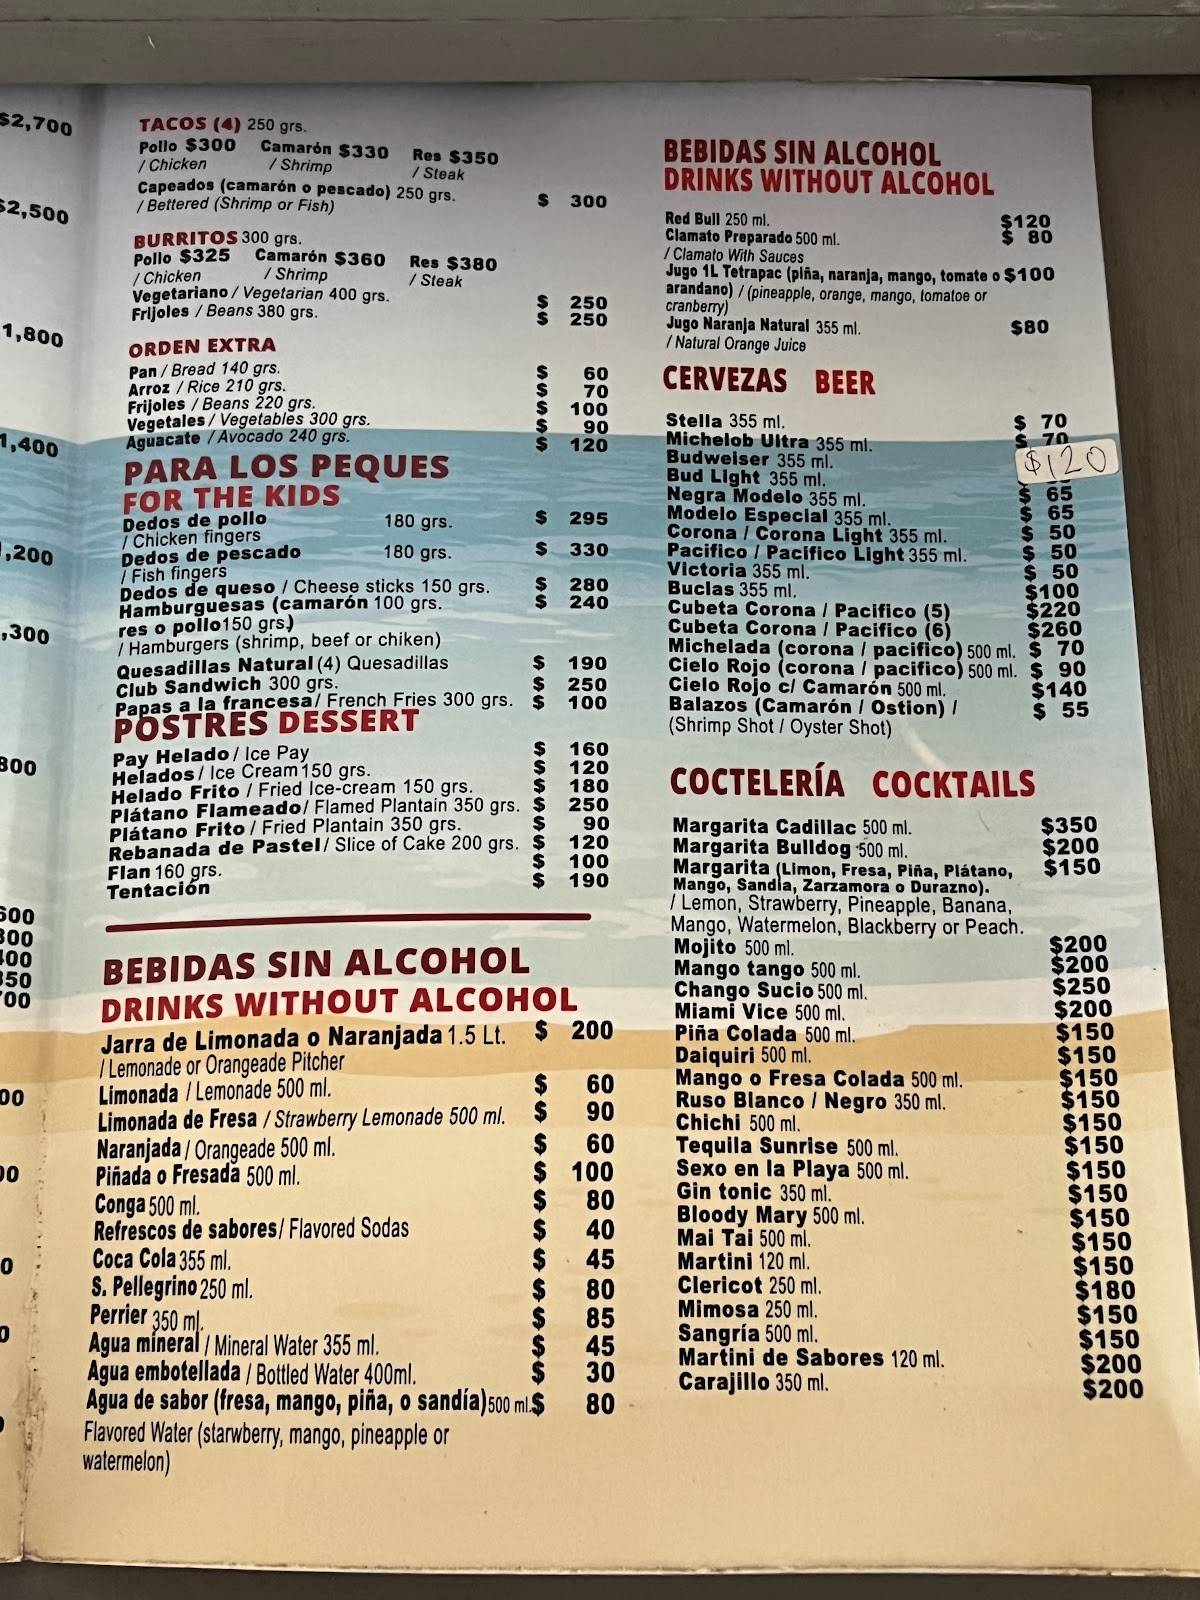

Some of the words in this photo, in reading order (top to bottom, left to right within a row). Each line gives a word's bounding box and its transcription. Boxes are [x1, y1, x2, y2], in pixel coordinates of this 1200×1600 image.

[0, 112, 72, 136] $2,700
[139, 117, 206, 132] TACOS
[214, 117, 240, 133] (4)
[248, 118, 274, 131] 250
[280, 122, 306, 134] grs.
[140, 140, 177, 154] Pollo
[186, 138, 236, 152] $300
[261, 140, 331, 155] Camarón
[339, 144, 388, 159] $330
[665, 139, 766, 164] BEBIDAS
[774, 140, 815, 164] SIN
[824, 140, 941, 166] ALCOHOL
[413, 149, 441, 161] Res
[449, 150, 498, 165] $350
[138, 178, 214, 196] Capeados
[221, 178, 296, 194] (camarón
[302, 184, 311, 193] o
[317, 184, 390, 200] pescado)
[397, 186, 423, 199] 250
[429, 191, 455, 203] grs.
[665, 167, 752, 192] DRINKS
[760, 168, 873, 194] WITHOUT
[881, 170, 994, 195] ALCOHOL
[666, 211, 690, 225] Red
[695, 212, 720, 225] Bull
[726, 213, 747, 226] 250
[752, 213, 769, 226] ml.
[1001, 214, 1050, 231] $120
[134, 231, 238, 249] BURRITOS
[242, 231, 269, 243] 300
[274, 235, 301, 247] grs.
[666, 228, 720, 242] Clamato
[725, 229, 792, 246] Preparado
[796, 232, 817, 245] 500
[822, 233, 840, 245] ml.
[666, 263, 697, 280] Jugo
[703, 264, 718, 277] 1L
[723, 264, 782, 282] Tetrapac
[787, 266, 824, 283] (piña,
[829, 268, 883, 285] naranja,
[888, 272, 936, 285] mango,
[940, 270, 987, 282] tomate
[992, 272, 1000, 282] o
[1004, 267, 1054, 283] $100
[129, 339, 200, 358] ORDEN
[208, 338, 276, 353] EXTRA
[663, 365, 787, 392] CERVEZAS
[816, 370, 876, 395] BEER
[666, 413, 722, 428] Stella
[730, 413, 757, 428] 355
[763, 414, 784, 428] ml.
[666, 431, 754, 447] Michelob
[760, 434, 809, 449] Ultra
[816, 437, 844, 452] 355
[850, 438, 872, 452] ml.
[667, 449, 769, 466] Budweiser
[777, 453, 805, 468] 355
[811, 454, 833, 468] ml.
[1024, 444, 1107, 479] $120
[125, 456, 217, 486] PARA
[231, 454, 298, 479] LOS
[312, 454, 449, 483] PEQUES
[124, 489, 183, 515] FOR
[194, 486, 253, 509] THE
[267, 485, 340, 507] KIDS
[740, 582, 768, 597] 355
[774, 583, 796, 598] ml.
[1025, 583, 1079, 602] $100
[1027, 600, 1080, 620] $220
[117, 659, 230, 680] Quesadillas
[239, 656, 313, 672] Natural
[318, 656, 340, 674] (4)
[348, 655, 448, 670] Quesadillas
[116, 682, 157, 698] Club
[165, 676, 261, 694] Sandwich
[269, 676, 300, 690] 300
[307, 678, 338, 693] grs.
[114, 709, 268, 743] POSTRES
[279, 709, 419, 734] DESSERT
[671, 762, 845, 797] COCTELERÍA
[873, 770, 1035, 798] COCKTAILS
[673, 817, 768, 837] Margarita
[776, 819, 856, 835] Cadillac
[863, 819, 887, 835] 500
[893, 820, 912, 835] ml.
[1041, 816, 1097, 836] $350
[674, 838, 769, 857] Margarita
[777, 839, 851, 859] Bulldog
[859, 842, 883, 858] 500
[888, 843, 907, 858] ml.
[1043, 838, 1099, 858] $200
[108, 865, 150, 880] Flan
[156, 863, 184, 879] 160
[190, 865, 221, 884] grs.
[107, 878, 210, 899] Tentación
[675, 938, 736, 958] Mojito
[745, 940, 769, 956] 500
[775, 940, 794, 956] ml.
[1050, 935, 1107, 956] $200
[104, 953, 255, 985] BEBIDAS
[268, 950, 331, 978] SIN
[344, 947, 529, 976] ALCOHOL
[102, 994, 223, 1023] DRINKS
[235, 988, 398, 1017] WITHOUT
[409, 987, 577, 1012] ALCOHOL
[101, 1035, 155, 1054] Jarra
[163, 1032, 187, 1052] de
[196, 1028, 299, 1050] Limonada
[307, 1032, 320, 1047] o
[329, 1024, 442, 1049] Naranjada
[448, 1025, 475, 1045] 1.5
[484, 1025, 505, 1044] Lt.
[676, 1136, 752, 1158] Tequila
[760, 1136, 838, 1154] Sunrise
[848, 1139, 872, 1157] 500
[878, 1139, 898, 1156] ml.
[1065, 1135, 1123, 1156] $150
[95, 1193, 145, 1218] Conga
[149, 1196, 174, 1216] 500
[180, 1195, 199, 1216] ml.
[93, 1248, 133, 1268] Coca
[140, 1247, 176, 1268] Cola
[180, 1250, 205, 1271] 355
[211, 1249, 231, 1270] ml.
[678, 1252, 752, 1270] Martini
[760, 1252, 784, 1270] 120
[790, 1252, 809, 1270] ml.
[1074, 1256, 1133, 1279] $150
[92, 1276, 106, 1296] S.
[113, 1275, 197, 1302] Pellegrino
[200, 1278, 226, 1299] 250
[232, 1278, 252, 1299] ml.
[678, 1275, 762, 1294] Clericot
[770, 1276, 795, 1294] 250
[801, 1276, 821, 1294] ml.
[1076, 1279, 1135, 1302] $180
[91, 1303, 148, 1325] Perrier
[152, 1310, 178, 1334] 350
[184, 1310, 203, 1332] ml.
[679, 1348, 754, 1366] Martini
[763, 1348, 788, 1366] de
[796, 1348, 884, 1366] Sabores
[892, 1350, 917, 1368] 120
[923, 1350, 944, 1368] ml.
[679, 1372, 769, 1395] Carajillo
[776, 1373, 802, 1391] 350
[808, 1372, 828, 1391] ml.
[1083, 1378, 1143, 1400] $200
[85, 1420, 145, 1442] Flavored
[151, 1421, 193, 1443] Water
[198, 1421, 283, 1450] (starwberry,
[290, 1428, 344, 1448] mango,
[352, 1422, 427, 1450] pineapple
[434, 1428, 449, 1444] or
[83, 1449, 170, 1477] watermelon)
